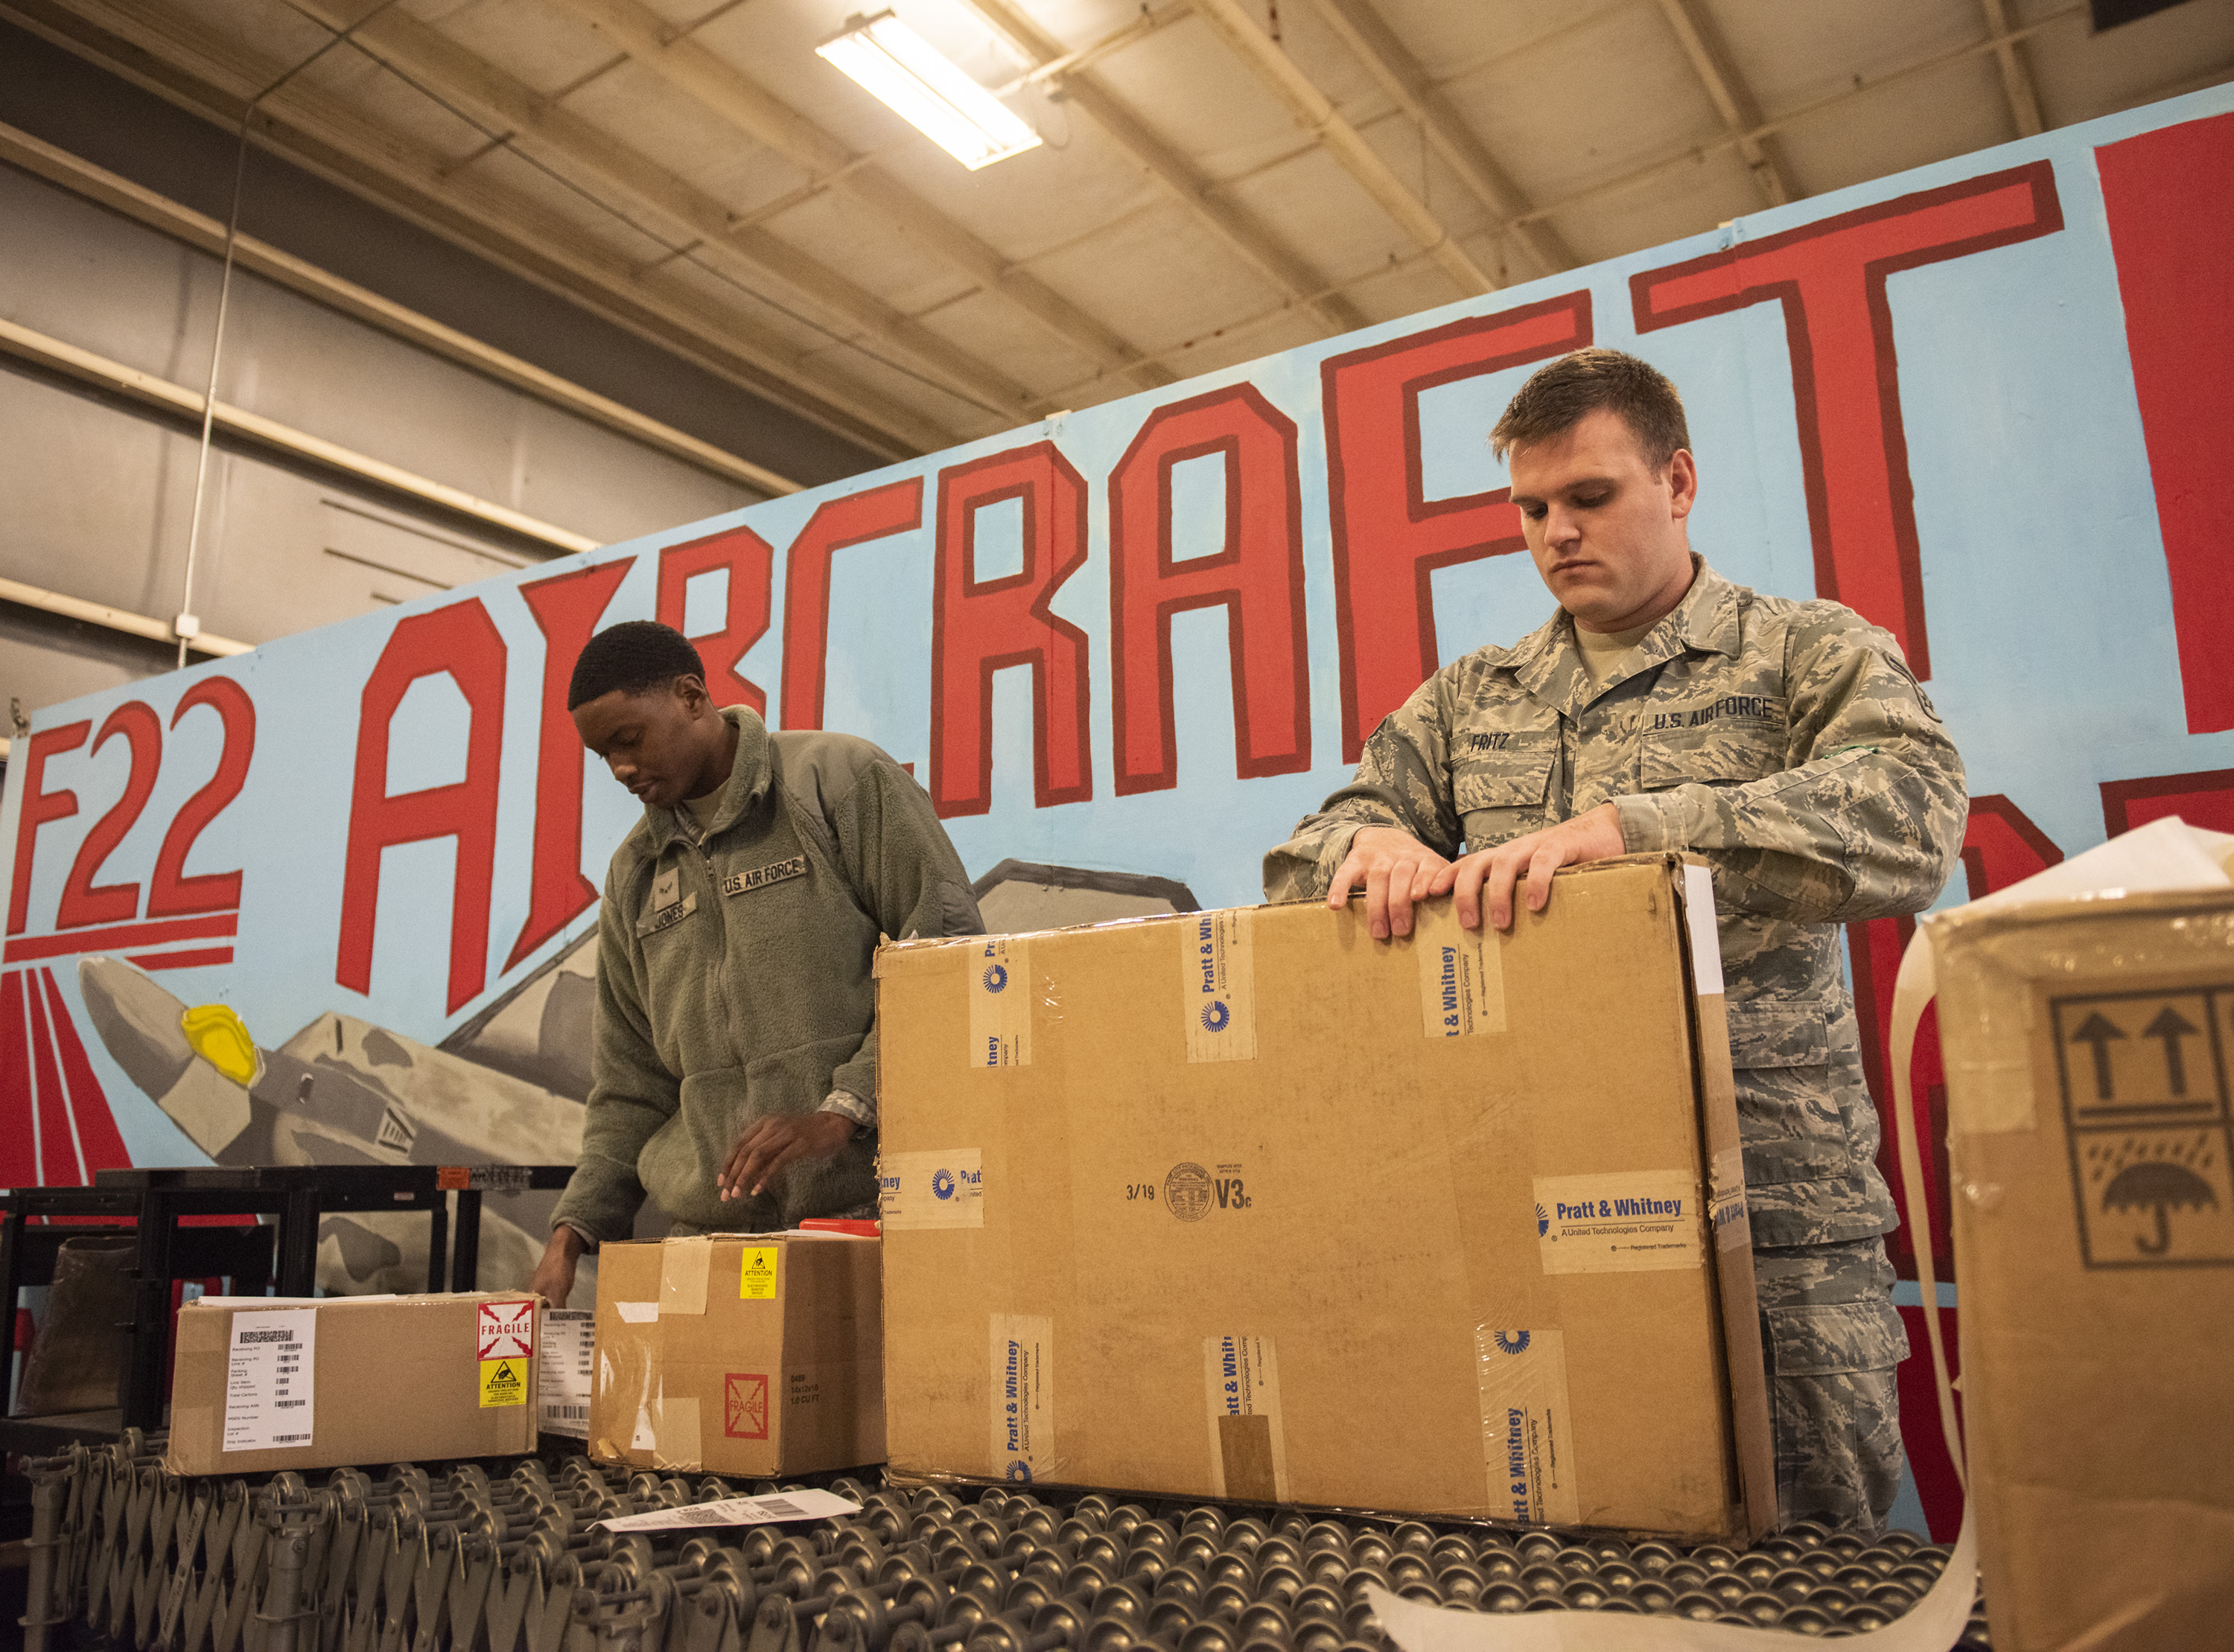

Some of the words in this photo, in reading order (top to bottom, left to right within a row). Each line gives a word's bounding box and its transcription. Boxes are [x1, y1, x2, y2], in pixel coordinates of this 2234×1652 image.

[1654, 713, 1685, 730] U.S.
[1688, 709, 1713, 728] AIR
[1715, 696, 1774, 718] FORCE
[1470, 733, 1510, 752] FRITZ
[6, 676, 256, 936] F22
[724, 877, 742, 893] U.S.
[745, 870, 763, 888] AIR
[764, 858, 799, 881] FORCE
[655, 905, 684, 929] JONES
[1200, 943, 1212, 954] &
[1218, 920, 1226, 963] Technologies
[1201, 957, 1215, 993] Pratt
[1441, 946, 1457, 1011] Whitney
[1463, 954, 1471, 987] Company
[1444, 1014, 1459, 1027] &
[1465, 989, 1474, 1035] Technologies
[1126, 1184, 1154, 1200] 3/19
[1556, 1202, 1596, 1219] Pratt
[1599, 1199, 1611, 1217] &
[1614, 1198, 1681, 1217] Whitney
[1562, 1228, 1568, 1237] A
[1568, 1228, 1591, 1236] United
[1593, 1226, 1638, 1235] Technologies
[1639, 1224, 1674, 1234] Company
[481, 1322, 529, 1336] FRAGILE
[1006, 1340, 1019, 1398] Whitney
[1244, 1358, 1253, 1403] Technologies
[486, 1382, 521, 1390] ATTENTION
[1224, 1381, 1238, 1393] &
[730, 1400, 763, 1413] FRAGILE
[1006, 1402, 1018, 1414] &
[1007, 1417, 1019, 1452] Pratt
[1507, 1407, 1525, 1478] Whitney
[1530, 1419, 1539, 1455] Company
[1511, 1482, 1527, 1496] &
[1534, 1455, 1544, 1508] Technologies
